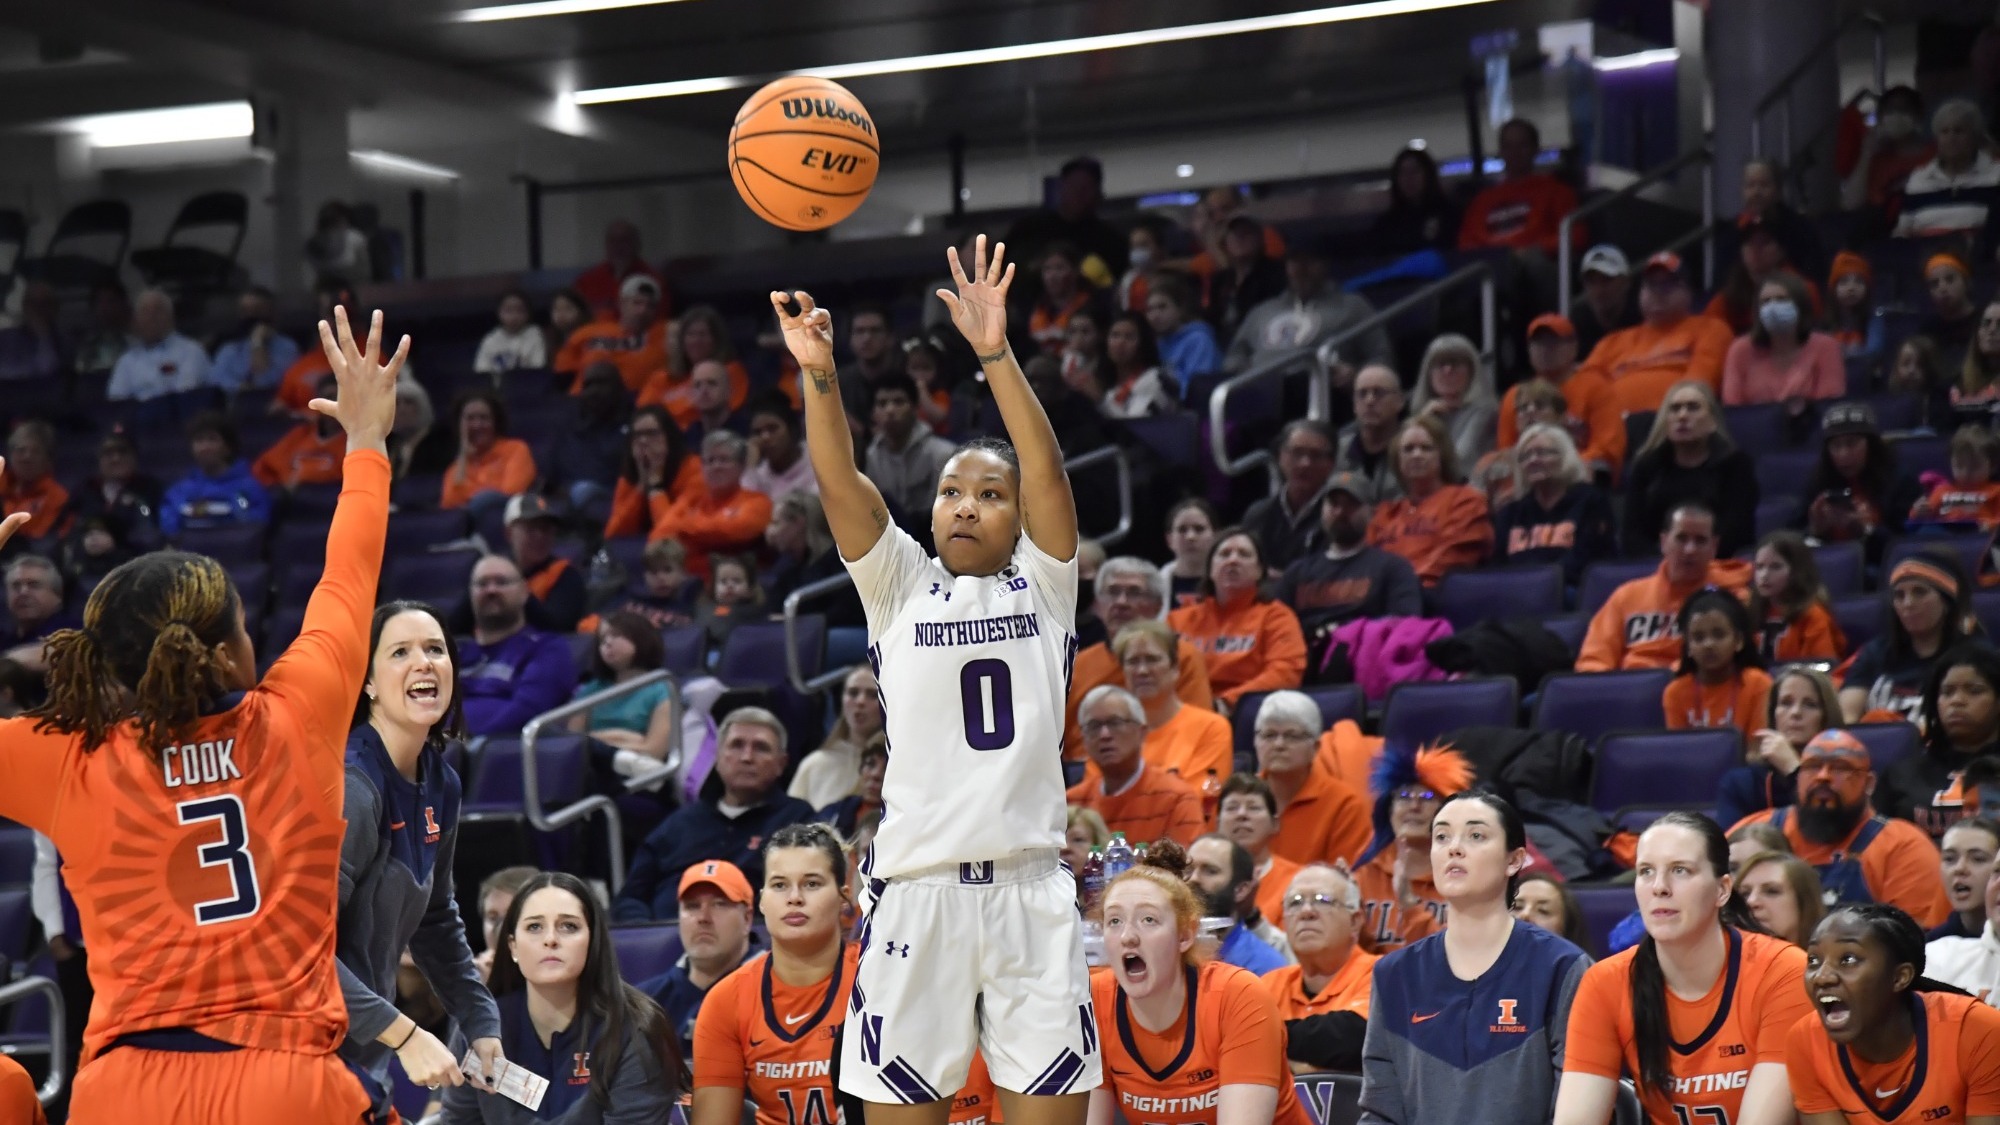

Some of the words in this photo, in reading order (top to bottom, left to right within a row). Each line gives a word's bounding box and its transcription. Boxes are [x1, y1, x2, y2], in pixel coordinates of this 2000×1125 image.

[780, 97, 872, 137] Wilson
[802, 148, 858, 174] EVO
[914, 613, 1040, 647] NORTHWESTERN
[960, 658, 1015, 751] 0
[162, 738, 242, 788] COOK
[176, 793, 261, 926] 3
[1078, 1001, 1096, 1056] N
[1498, 999, 1518, 1025] I
[861, 1011, 883, 1067] N
[756, 1059, 832, 1079] FIGHTIN
[1122, 1089, 1219, 1113] FIGHTING
